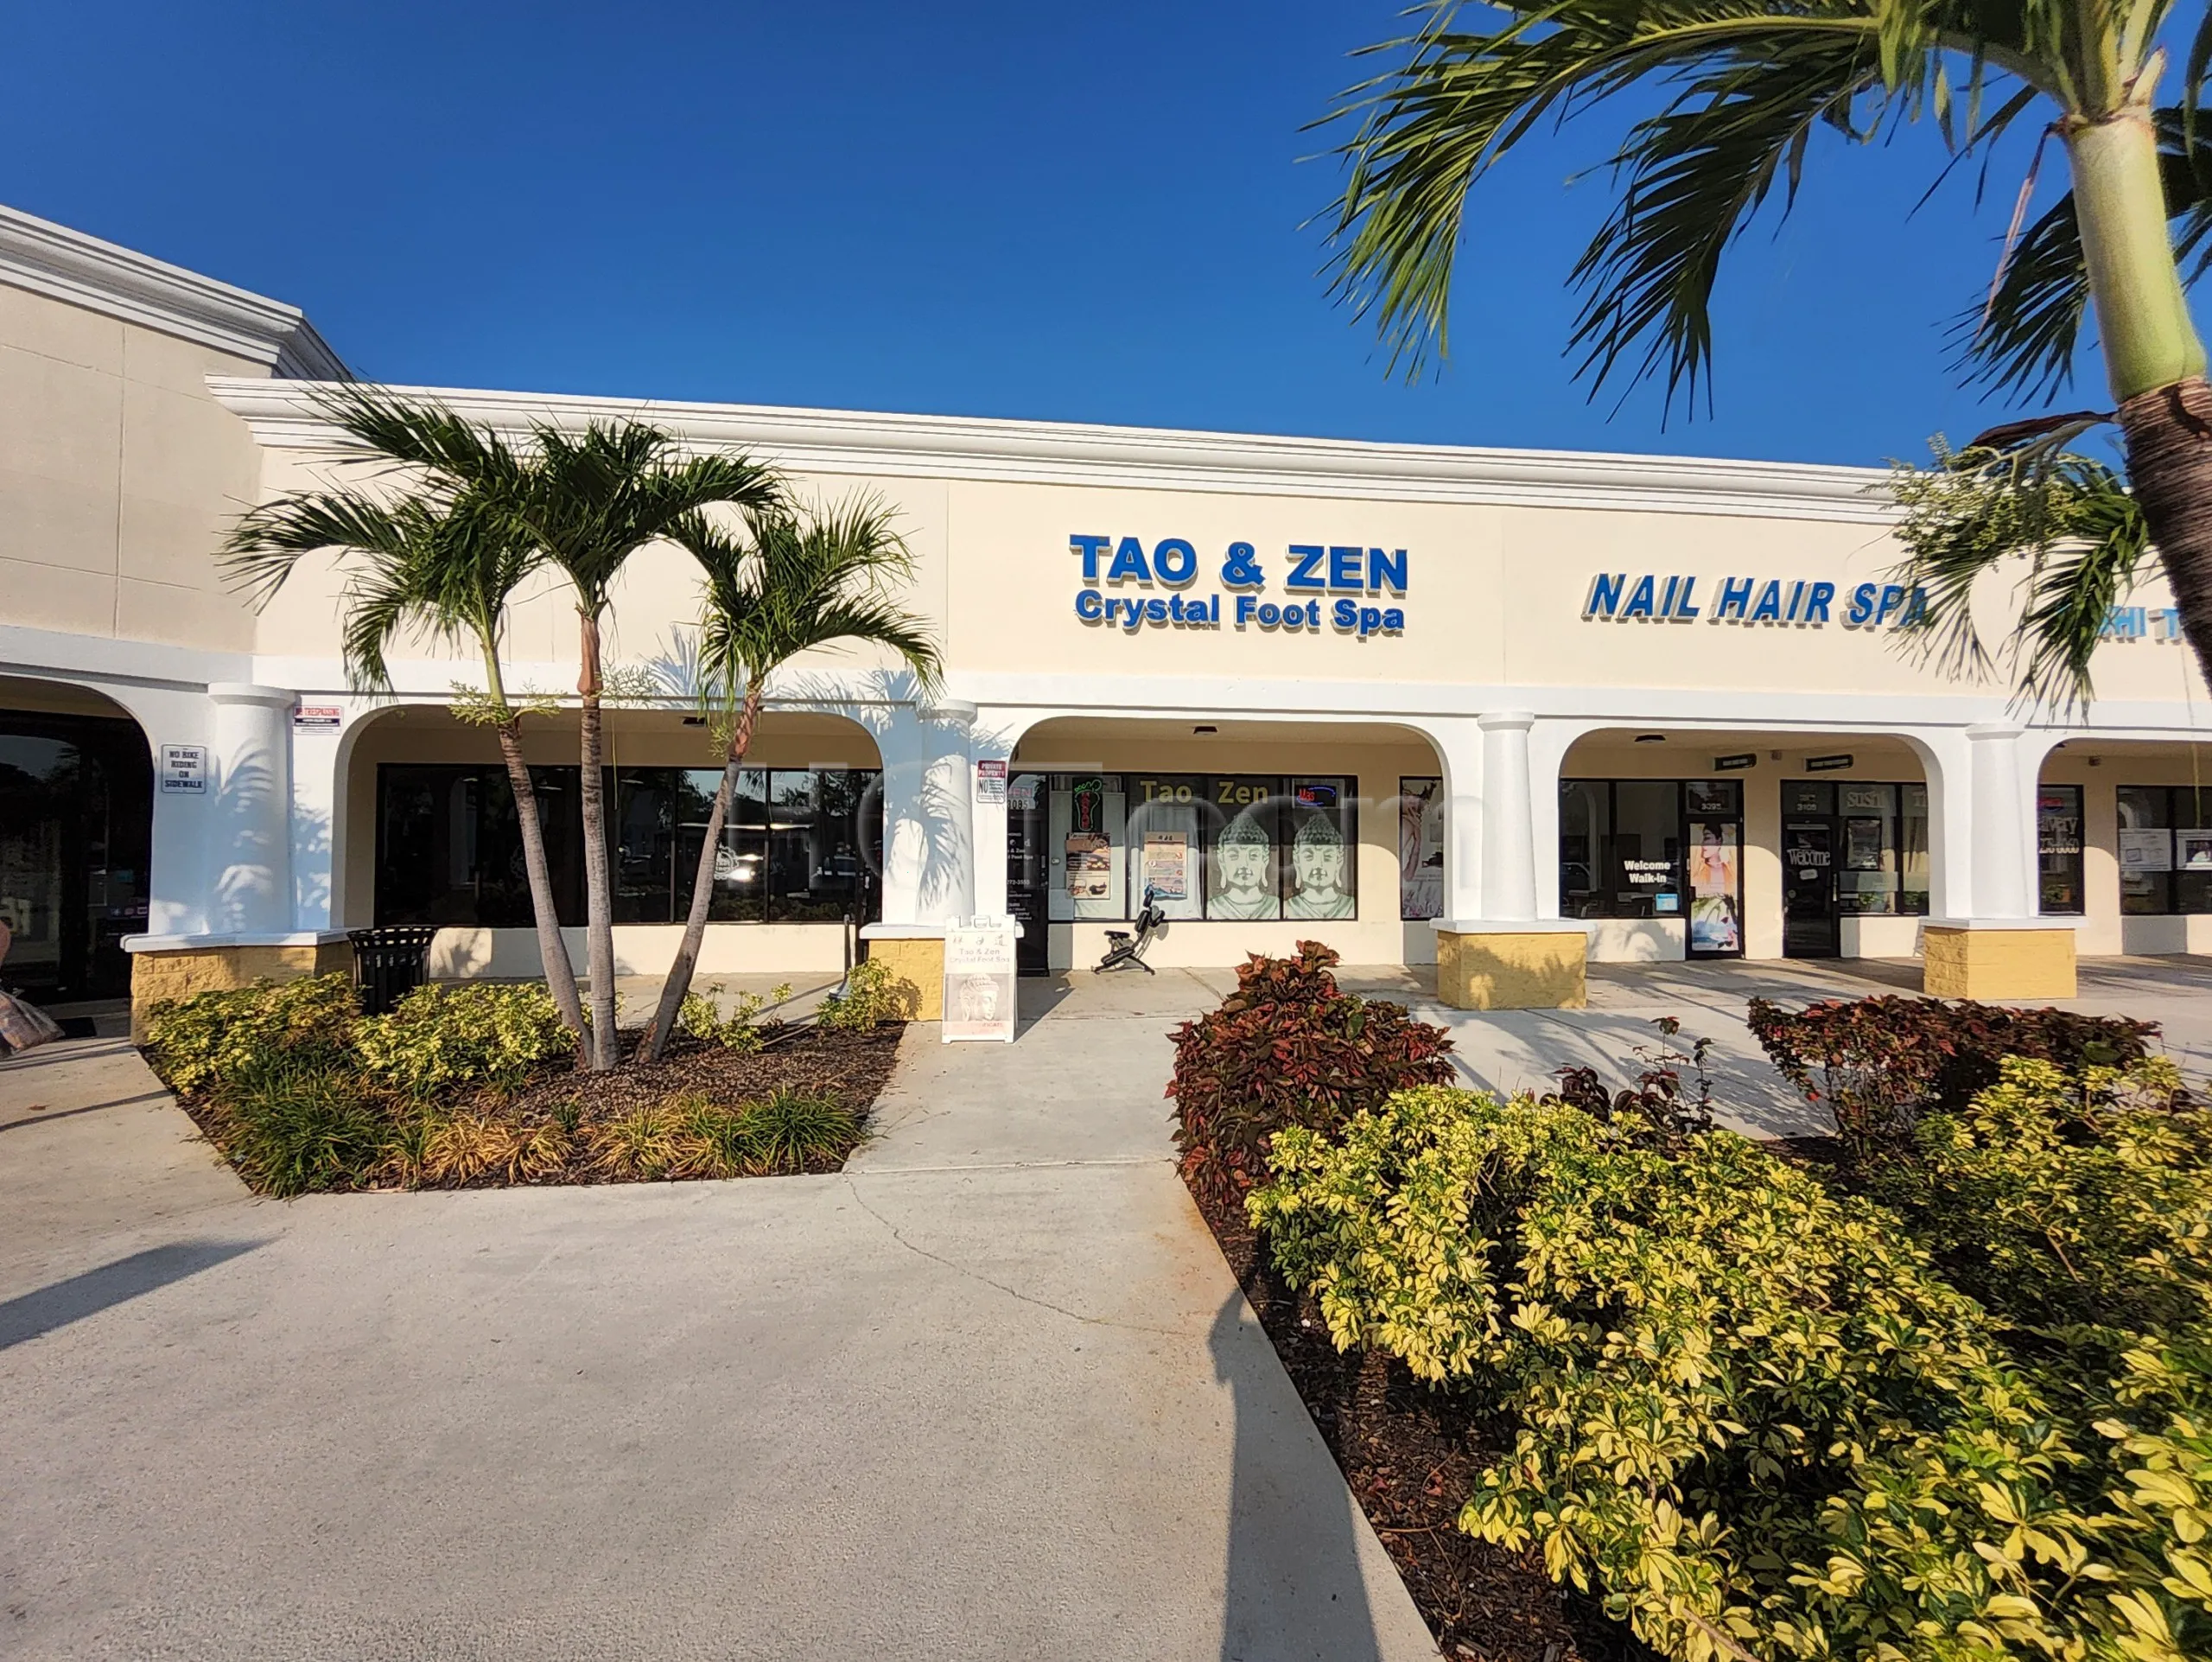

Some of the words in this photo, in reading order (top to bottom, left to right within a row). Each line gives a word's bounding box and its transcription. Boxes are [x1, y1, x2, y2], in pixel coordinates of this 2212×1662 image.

[1069, 534, 1198, 585] TAO
[1221, 542, 1267, 587] &
[1285, 544, 1408, 594] ZEN
[1583, 573, 1700, 621] NAIL
[1709, 576, 1835, 627] HAIR
[1841, 583, 1930, 630] SPA
[1075, 589, 1219, 632] Crystal
[1235, 595, 1320, 632] Foot
[1332, 599, 1405, 638] Spa
[979, 780, 988, 793] NO
[1140, 780, 1192, 804] Tao
[1218, 781, 1268, 804] Zen
[1624, 860, 1671, 870] Welcome
[1786, 848, 1831, 866] Welcome
[1629, 872, 1667, 883] Walk-in
